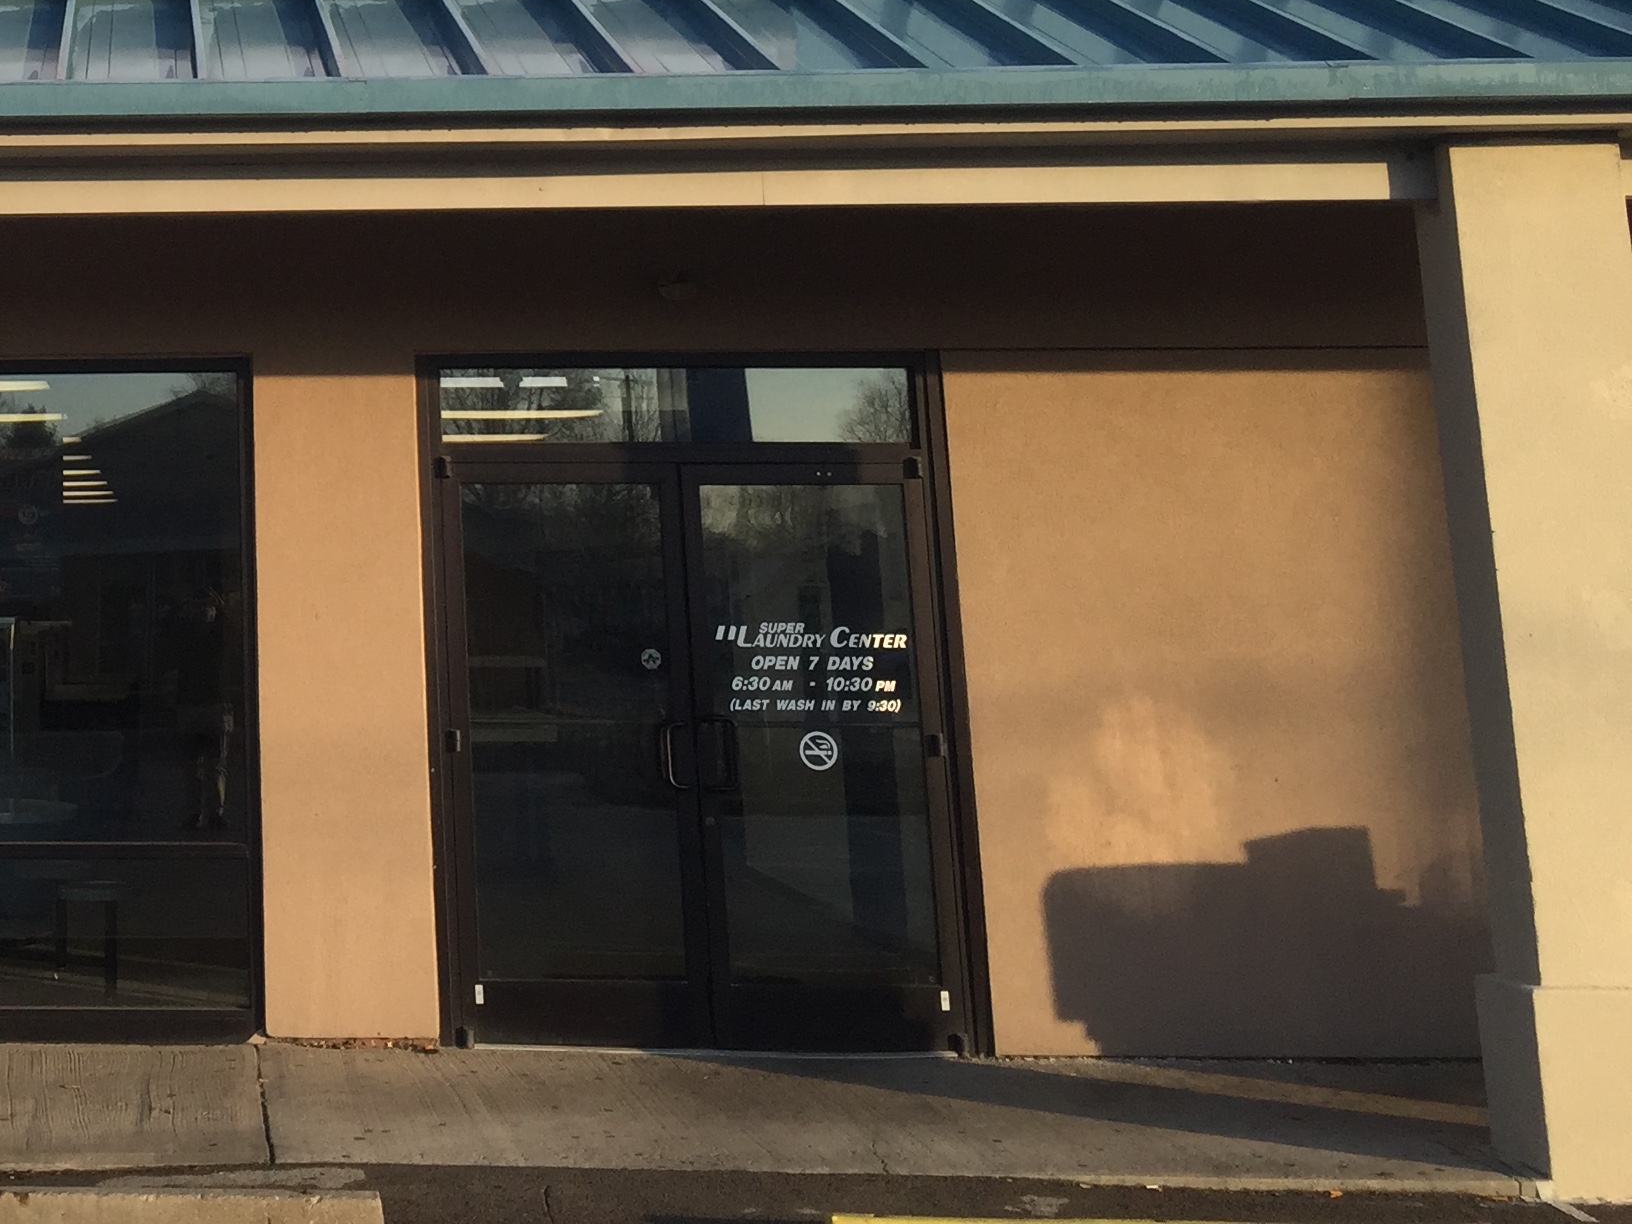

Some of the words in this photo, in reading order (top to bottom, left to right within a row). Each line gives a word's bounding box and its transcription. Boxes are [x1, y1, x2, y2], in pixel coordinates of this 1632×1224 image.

[759, 622, 805, 634] SUPER
[737, 625, 826, 648] LAUNDRY
[830, 626, 908, 649] CENTER
[751, 655, 800, 670] OPEN
[808, 656, 820, 670] 7
[827, 656, 874, 670] DAYS
[731, 676, 771, 691] 6:30
[771, 680, 794, 691] AM
[826, 676, 873, 691] 10:30
[875, 680, 897, 692] PM
[729, 698, 770, 712] (LAST
[776, 699, 815, 711] WASH
[821, 699, 836, 711] IN
[842, 699, 862, 711] BY
[867, 698, 902, 713] 9:30)
